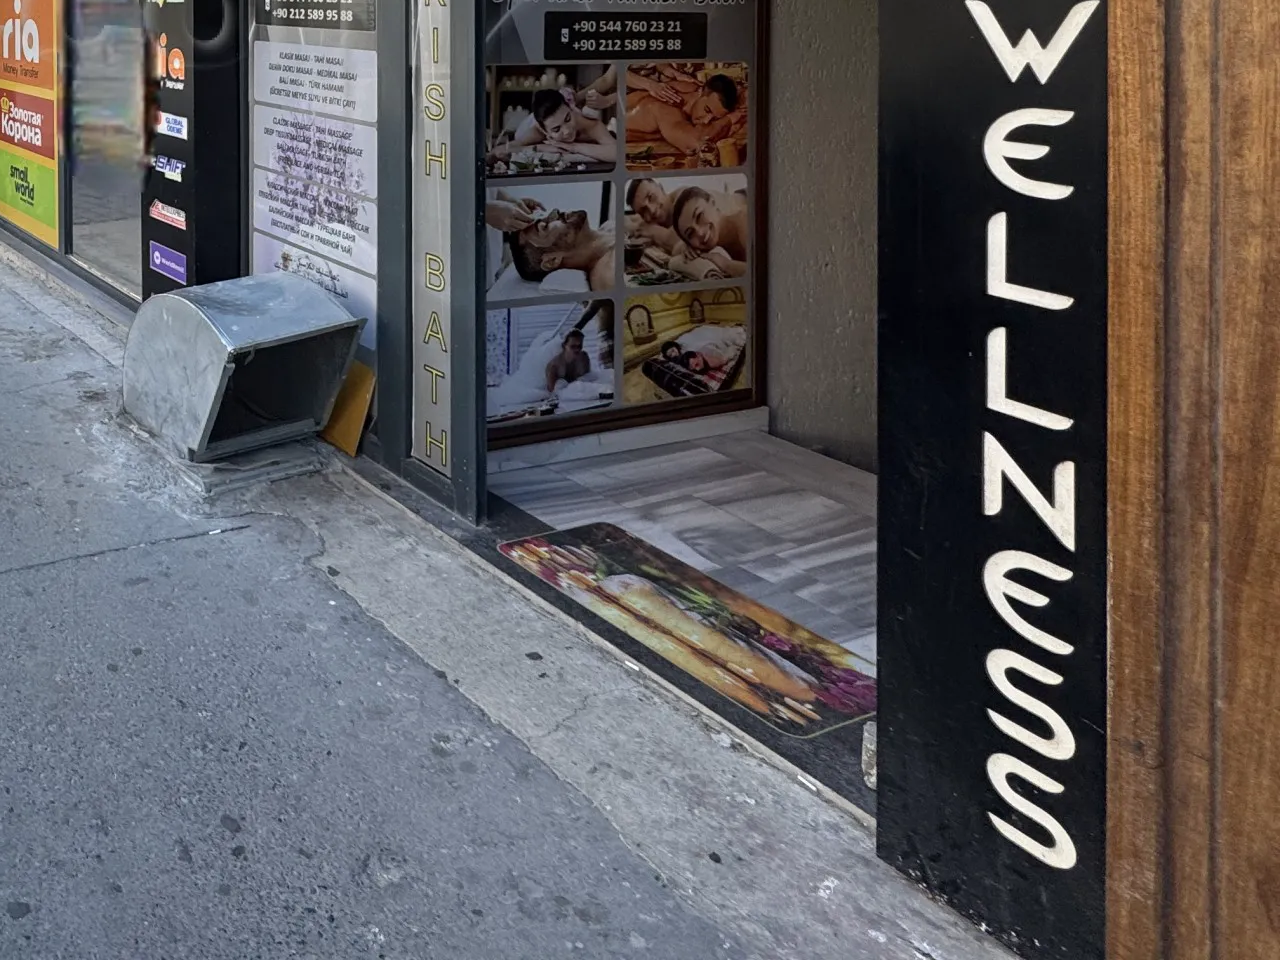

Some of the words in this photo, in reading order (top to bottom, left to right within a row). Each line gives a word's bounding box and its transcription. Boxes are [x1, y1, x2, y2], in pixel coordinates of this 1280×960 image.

[272, 8, 288, 19] +90
[289, 9, 306, 20] 212
[307, 10, 325, 21] 589
[326, 10, 339, 21] 95
[341, 11, 353, 22] 88
[573, 21, 597, 32] +90
[599, 21, 622, 32] 544
[624, 21, 647, 32] 760
[649, 21, 665, 32] 23
[667, 21, 682, 32] 21
[572, 40, 596, 51] +90
[598, 40, 622, 51] 212
[624, 40, 647, 51] 589
[649, 40, 665, 51] 95
[667, 40, 682, 51] 88
[2, 62, 19, 78] Money
[19, 64, 40, 79] Transfer
[9, 101, 42, 127] Золотая
[1, 112, 42, 147] Корона
[10, 165, 29, 182] small
[14, 180, 35, 201] world
[341, 231, 356, 243] БАНЯ
[423, 252, 448, 468] BATH
[965, 0, 1101, 871] WELLNESS
